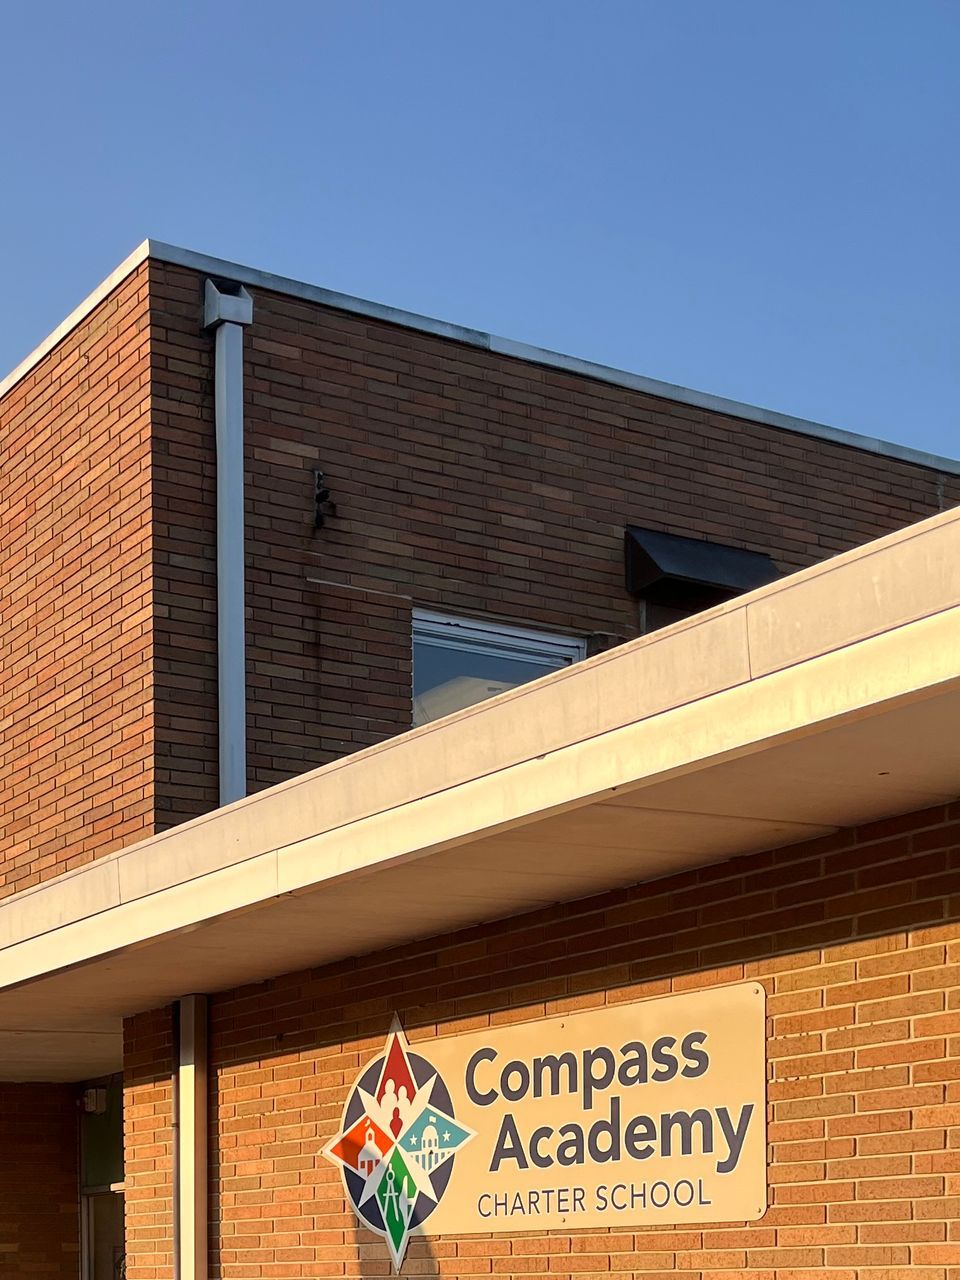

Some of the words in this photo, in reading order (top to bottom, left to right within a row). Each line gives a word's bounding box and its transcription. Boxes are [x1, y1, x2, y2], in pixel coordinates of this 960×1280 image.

[465, 1031, 710, 1110] Compass
[489, 1096, 755, 1173] Academy
[477, 1186, 586, 1218] CHARTER
[595, 1179, 712, 1212] SCHOOL
